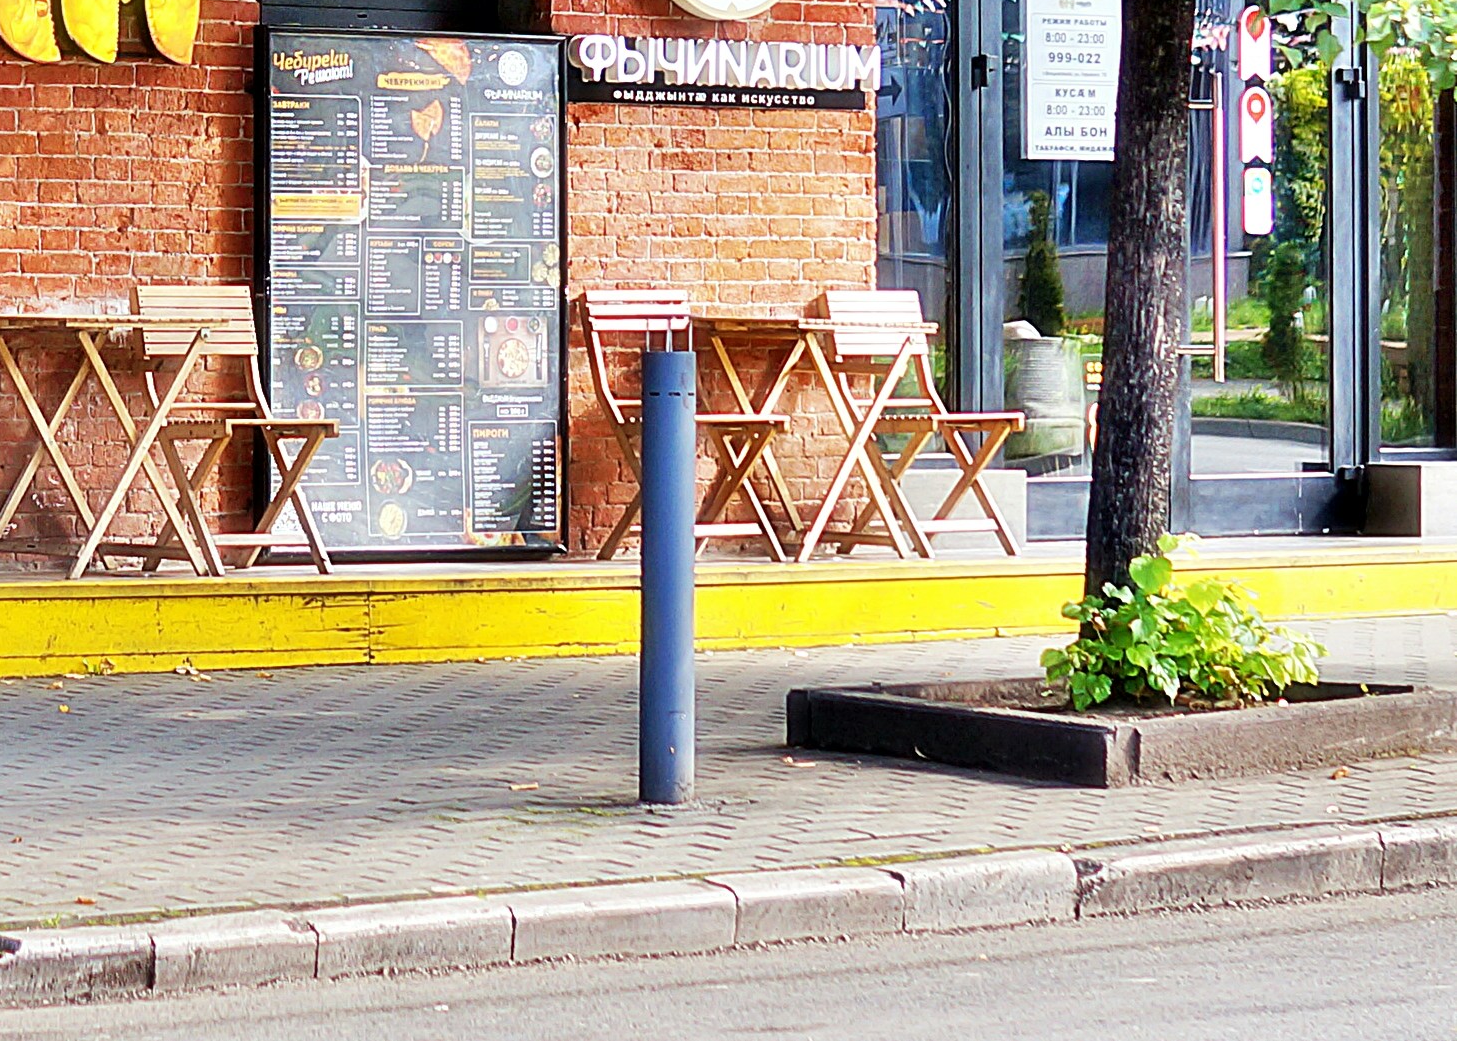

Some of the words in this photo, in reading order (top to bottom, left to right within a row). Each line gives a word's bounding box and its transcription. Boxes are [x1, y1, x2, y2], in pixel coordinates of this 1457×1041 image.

[1045, 32, 1066, 43] 8:00
[1077, 33, 1105, 44] 23:00
[273, 49, 349, 71] Чебуреки
[1048, 52, 1101, 64] 999-022
[294, 59, 354, 86] Решают!
[712, 92, 736, 104] как
[741, 93, 815, 107] искусство
[1046, 104, 1067, 115] 8:00
[1078, 105, 1105, 116] 23:00
[1045, 126, 1074, 137] АЛЫ
[1081, 127, 1107, 137] БОН
[473, 428, 509, 438] ПИРОГИ
